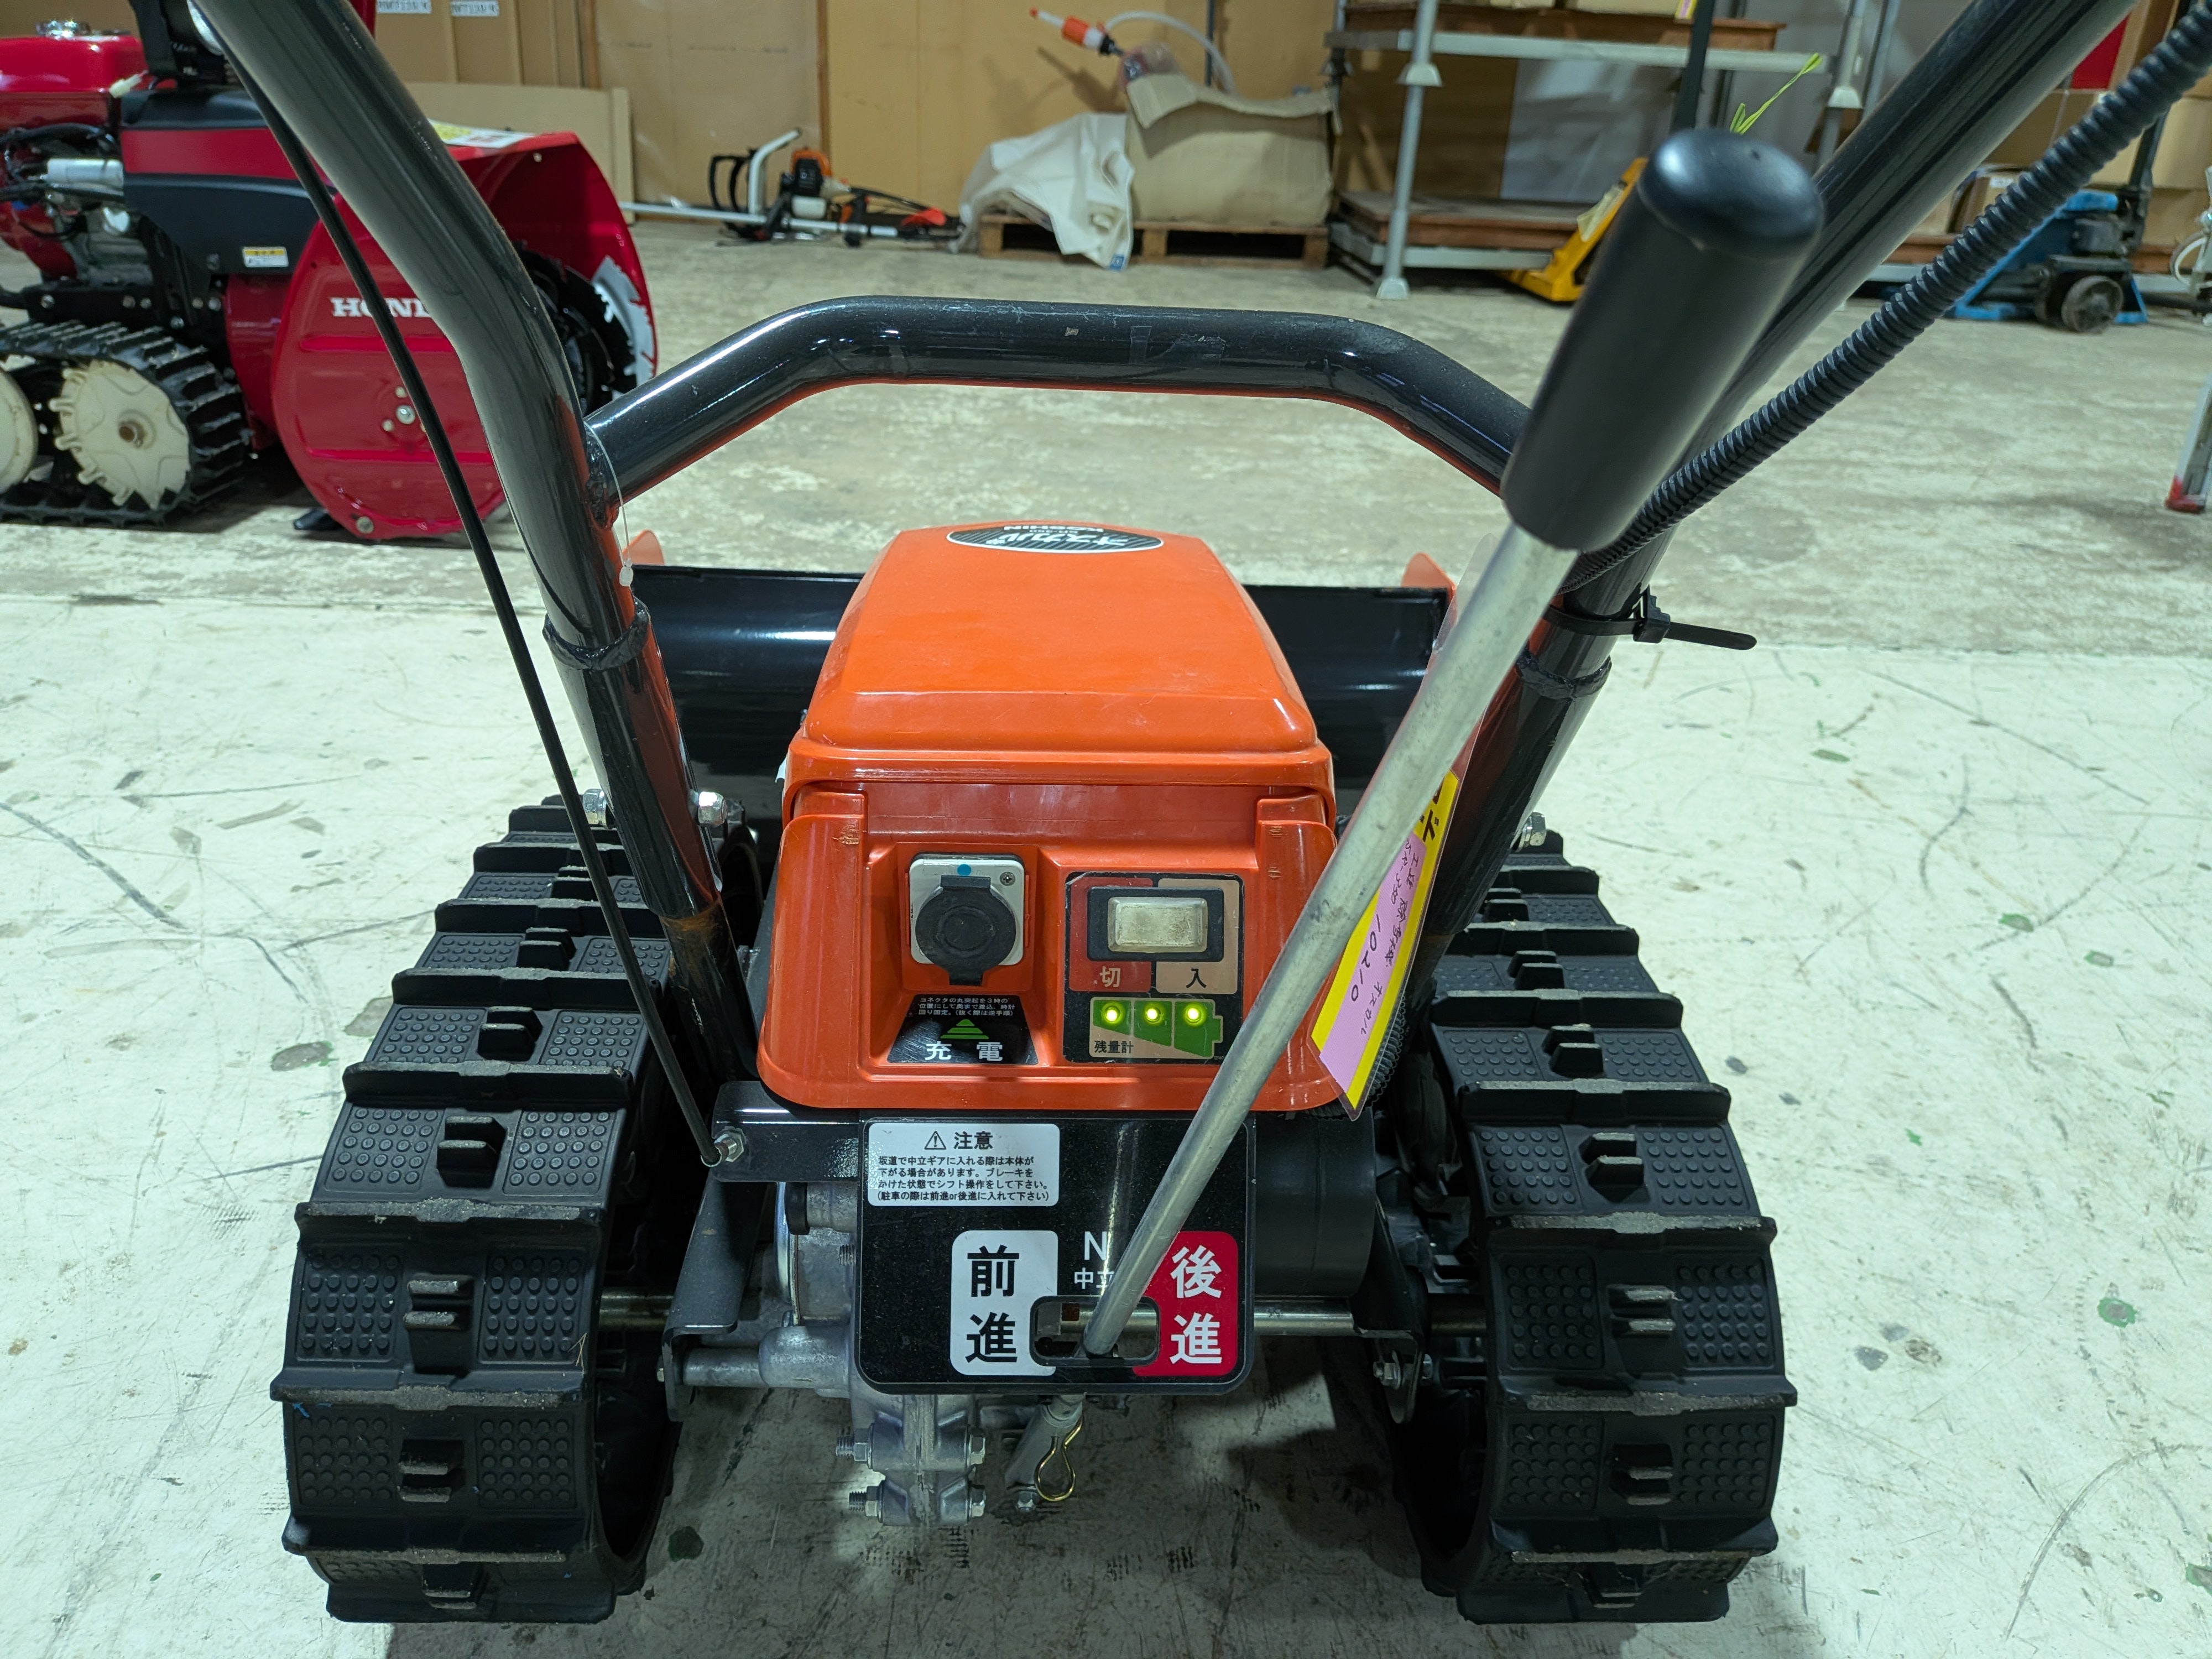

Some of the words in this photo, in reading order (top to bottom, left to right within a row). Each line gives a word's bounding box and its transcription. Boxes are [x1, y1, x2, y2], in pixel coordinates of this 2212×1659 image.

[1351, 914, 1381, 1001] 10210
[1099, 966, 1121, 988] 切
[1186, 968, 1207, 988] 入
[1094, 1040, 1134, 1053] 残量計
[953, 1131, 994, 1150] 注意
[878, 1156, 1034, 1166] 坂道で中立ギアに入れる際は本体が
[878, 1168, 1033, 1178] 下がる場合があります。ブレーキを
[878, 1179, 1048, 1190] かけた状態でシフト操作をして下さい。
[1084, 1231, 1107, 1260] N
[965, 1245, 1020, 1363] 前進
[1170, 1245, 1222, 1364] 後進
